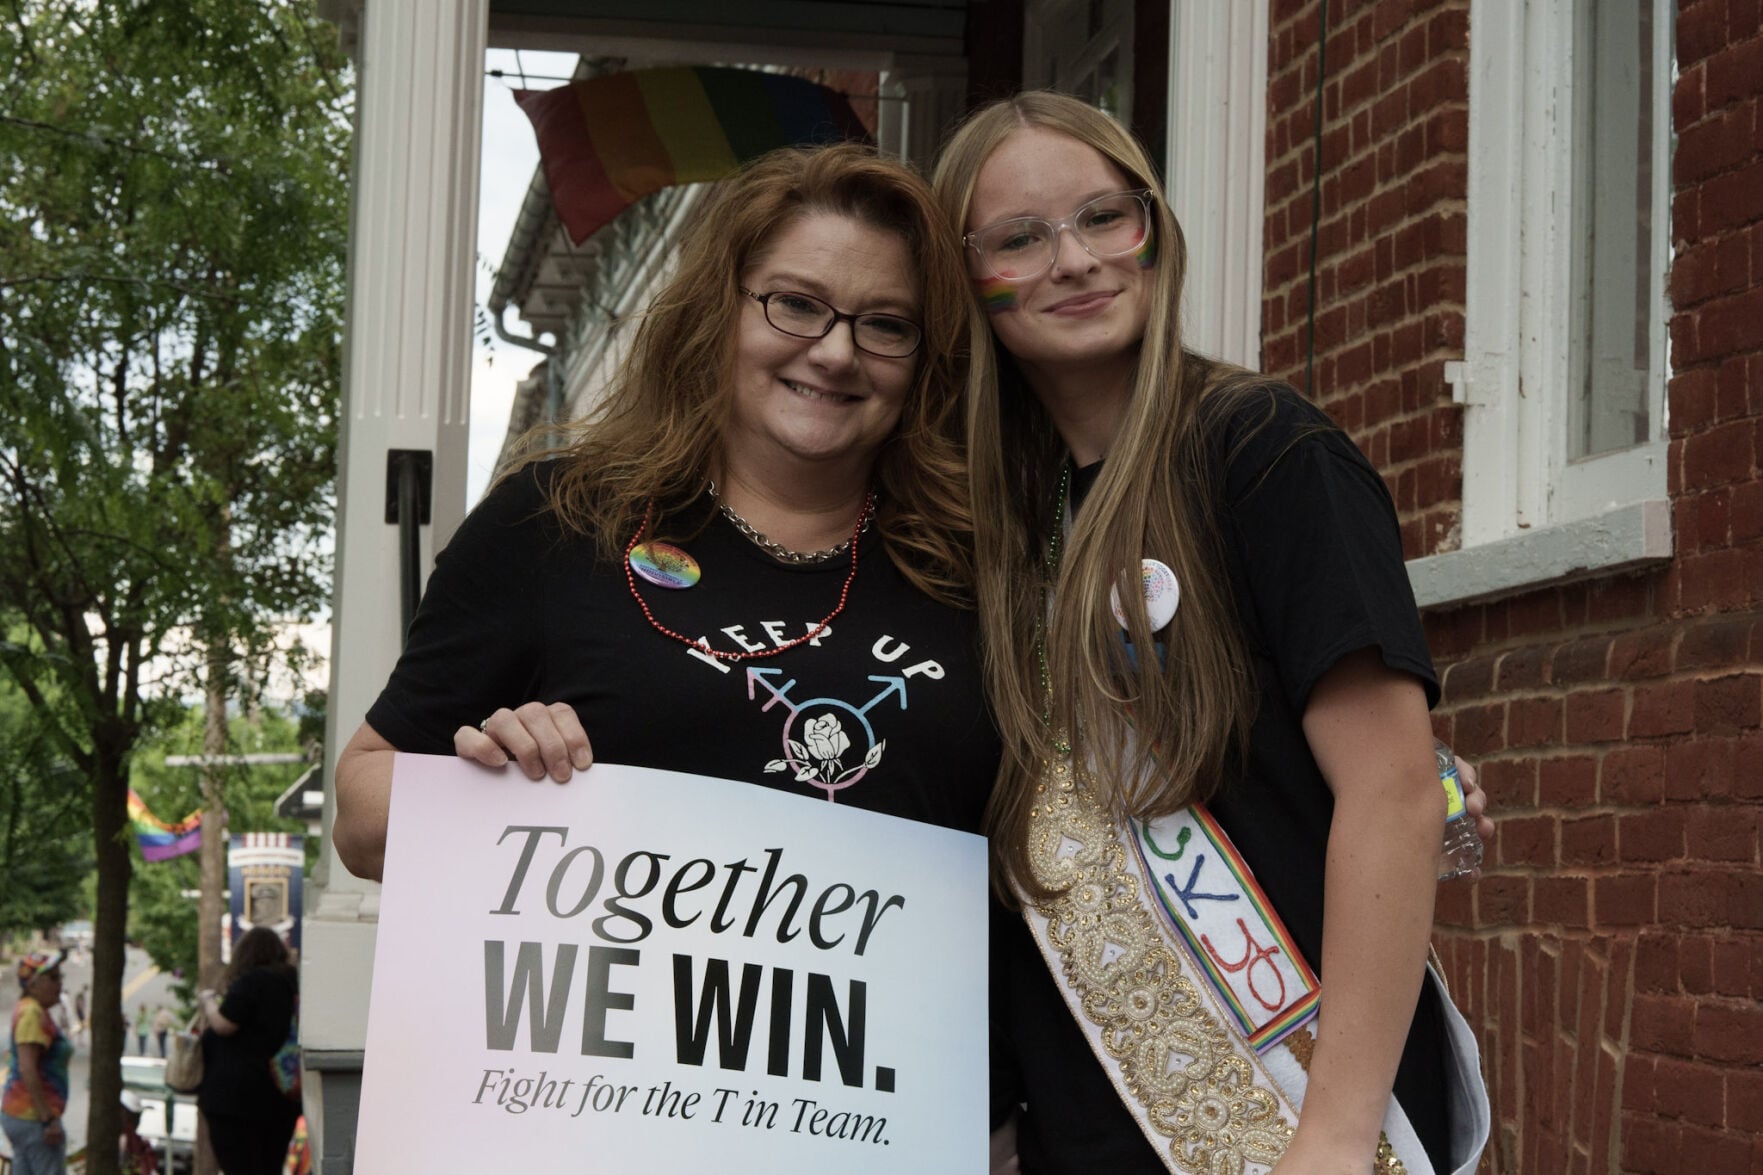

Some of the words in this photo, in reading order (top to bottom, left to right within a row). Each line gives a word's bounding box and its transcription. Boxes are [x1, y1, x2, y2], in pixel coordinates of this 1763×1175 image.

[686, 620, 833, 674] KEEP
[871, 634, 946, 680] UP
[488, 825, 906, 957] Together
[484, 939, 641, 1060] WE
[672, 952, 897, 1094] WIN.
[472, 1069, 574, 1114] Fight
[571, 1075, 639, 1118] for
[642, 1081, 702, 1120] the
[711, 1088, 740, 1124] T
[741, 1090, 780, 1130] in
[790, 1098, 890, 1146] Team.
